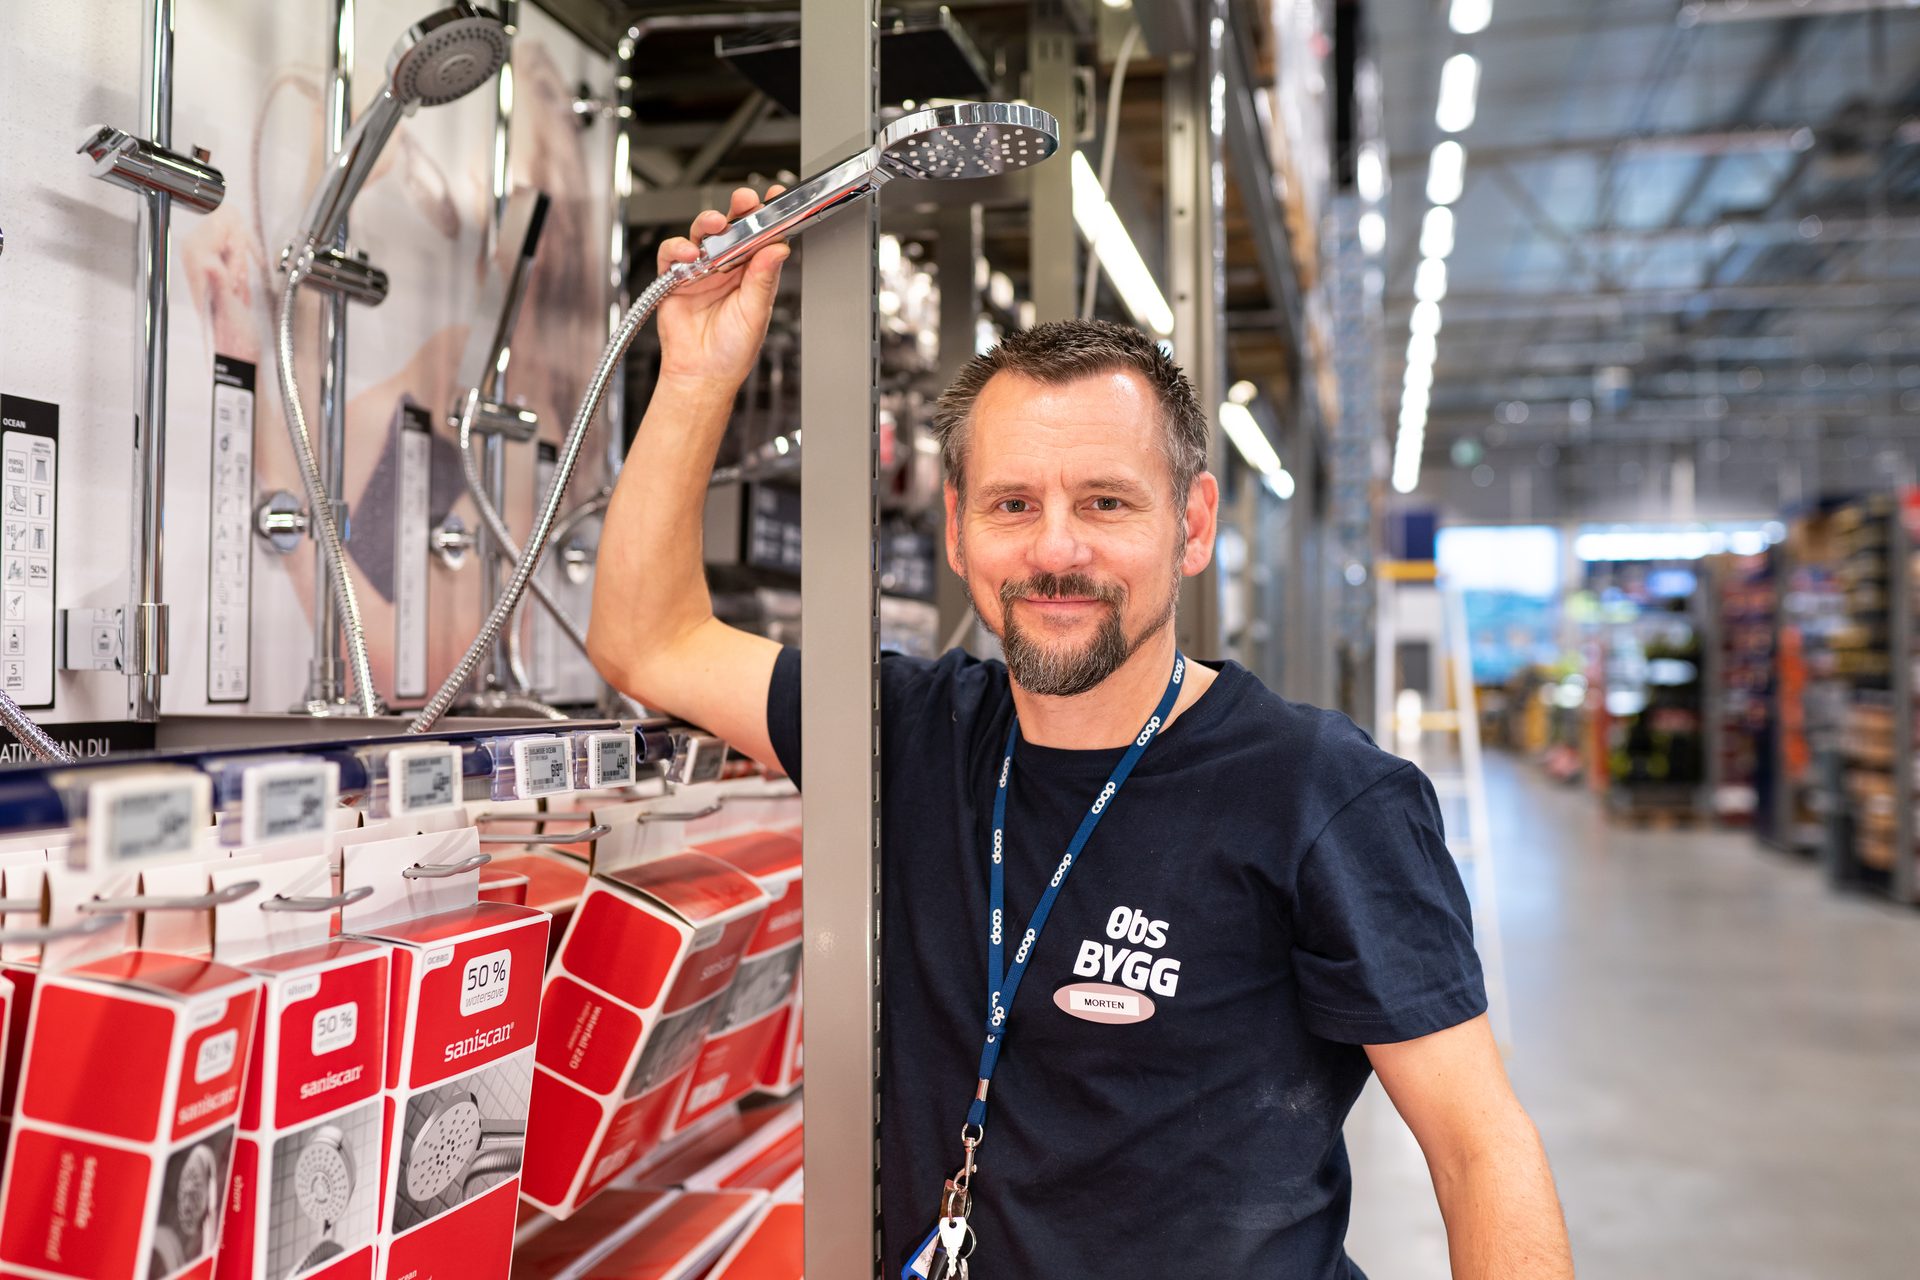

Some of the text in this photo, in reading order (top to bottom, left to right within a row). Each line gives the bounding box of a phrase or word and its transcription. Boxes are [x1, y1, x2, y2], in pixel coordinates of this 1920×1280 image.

[2, 417, 26, 429] OCEAN
[11, 664, 17, 675] 5
[1172, 659, 1185, 684] coop
[1137, 716, 1160, 746] coop
[87, 738, 110, 757] DU
[999, 756, 1011, 788] coop
[1091, 781, 1116, 815] coop
[992, 828, 1002, 865] coop
[1051, 853, 1072, 888] coop
[991, 908, 1002, 945] coop
[1105, 905, 1170, 949] Obs
[427, 953, 449, 966] ocean
[1015, 928, 1036, 964] coop
[467, 964, 489, 991] 50
[1072, 939, 1182, 998] BYGG
[465, 987, 505, 1007] watersave
[1084, 998, 1125, 1010] MORTEN
[318, 1015, 337, 1037] 50
[568, 1006, 602, 1070] waterfall 220
[233, 1174, 243, 1213] shore
